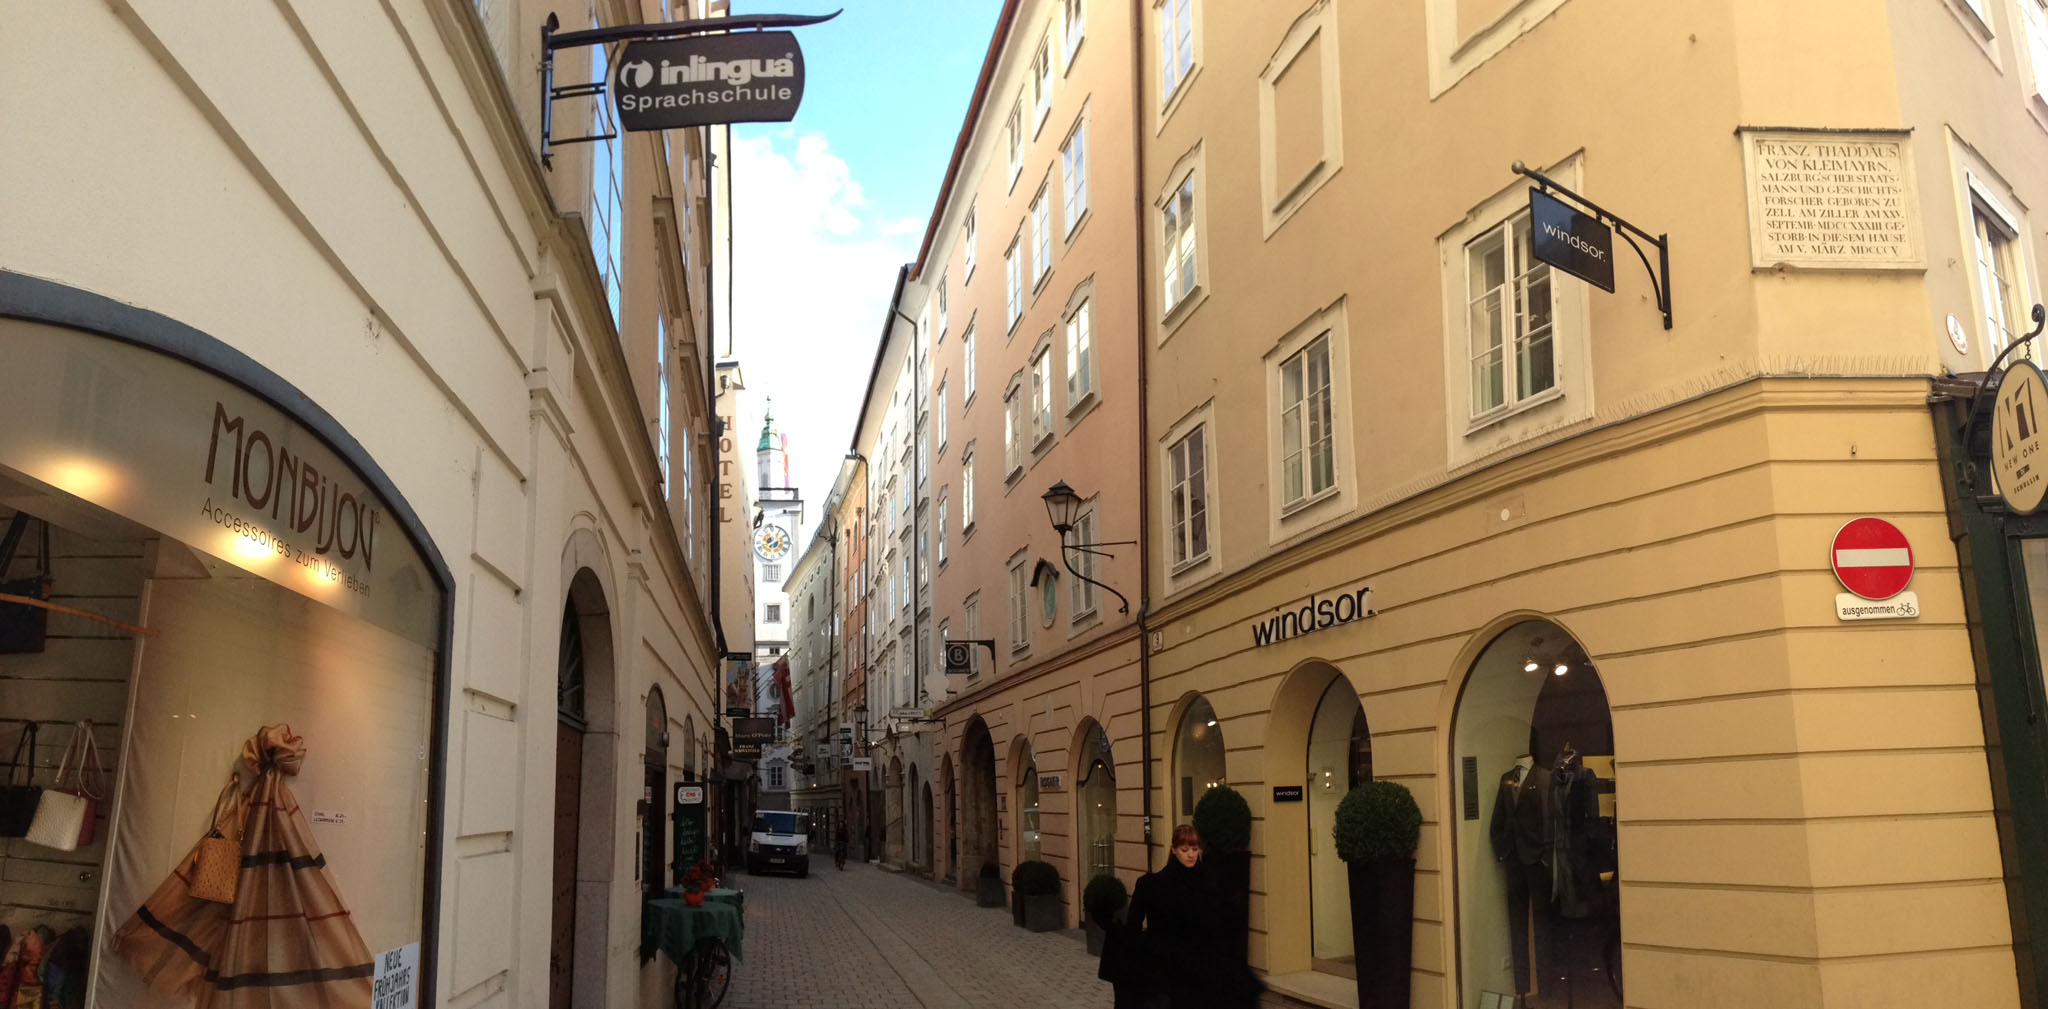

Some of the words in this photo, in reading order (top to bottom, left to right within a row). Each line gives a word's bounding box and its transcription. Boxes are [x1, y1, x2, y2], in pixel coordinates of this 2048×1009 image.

[621, 85, 792, 112] Sprachschule
[1758, 144, 1809, 156] FRANZ
[1765, 158, 1799, 170] VON
[1762, 184, 1797, 194] MANN
[1800, 185, 1824, 194] UND
[1765, 197, 1824, 206] FORSCHER
[1827, 197, 1880, 207] GEBOREN
[1884, 198, 1899, 207] ZU
[1765, 208, 1795, 217] ZELL
[1799, 208, 1816, 217] AM
[1819, 209, 1859, 218] ZILLER
[1863, 209, 1880, 219] AM
[1808, 233, 1820, 242] IN
[1822, 233, 1865, 242] DIESEM
[1869, 234, 1906, 243] HAUSE
[1777, 244, 1797, 254] AM
[1811, 242, 1846, 255] MÄRZ
[2004, 455, 2018, 472] NEW
[2022, 441, 2040, 458] ONE
[719, 416, 734, 523] HOTEL
[201, 497, 291, 558] Accessoires
[295, 548, 320, 574] zum
[324, 560, 371, 598] Verlieben
[1842, 605, 1896, 617] ausgenommen
[384, 948, 402, 974] NEUE
